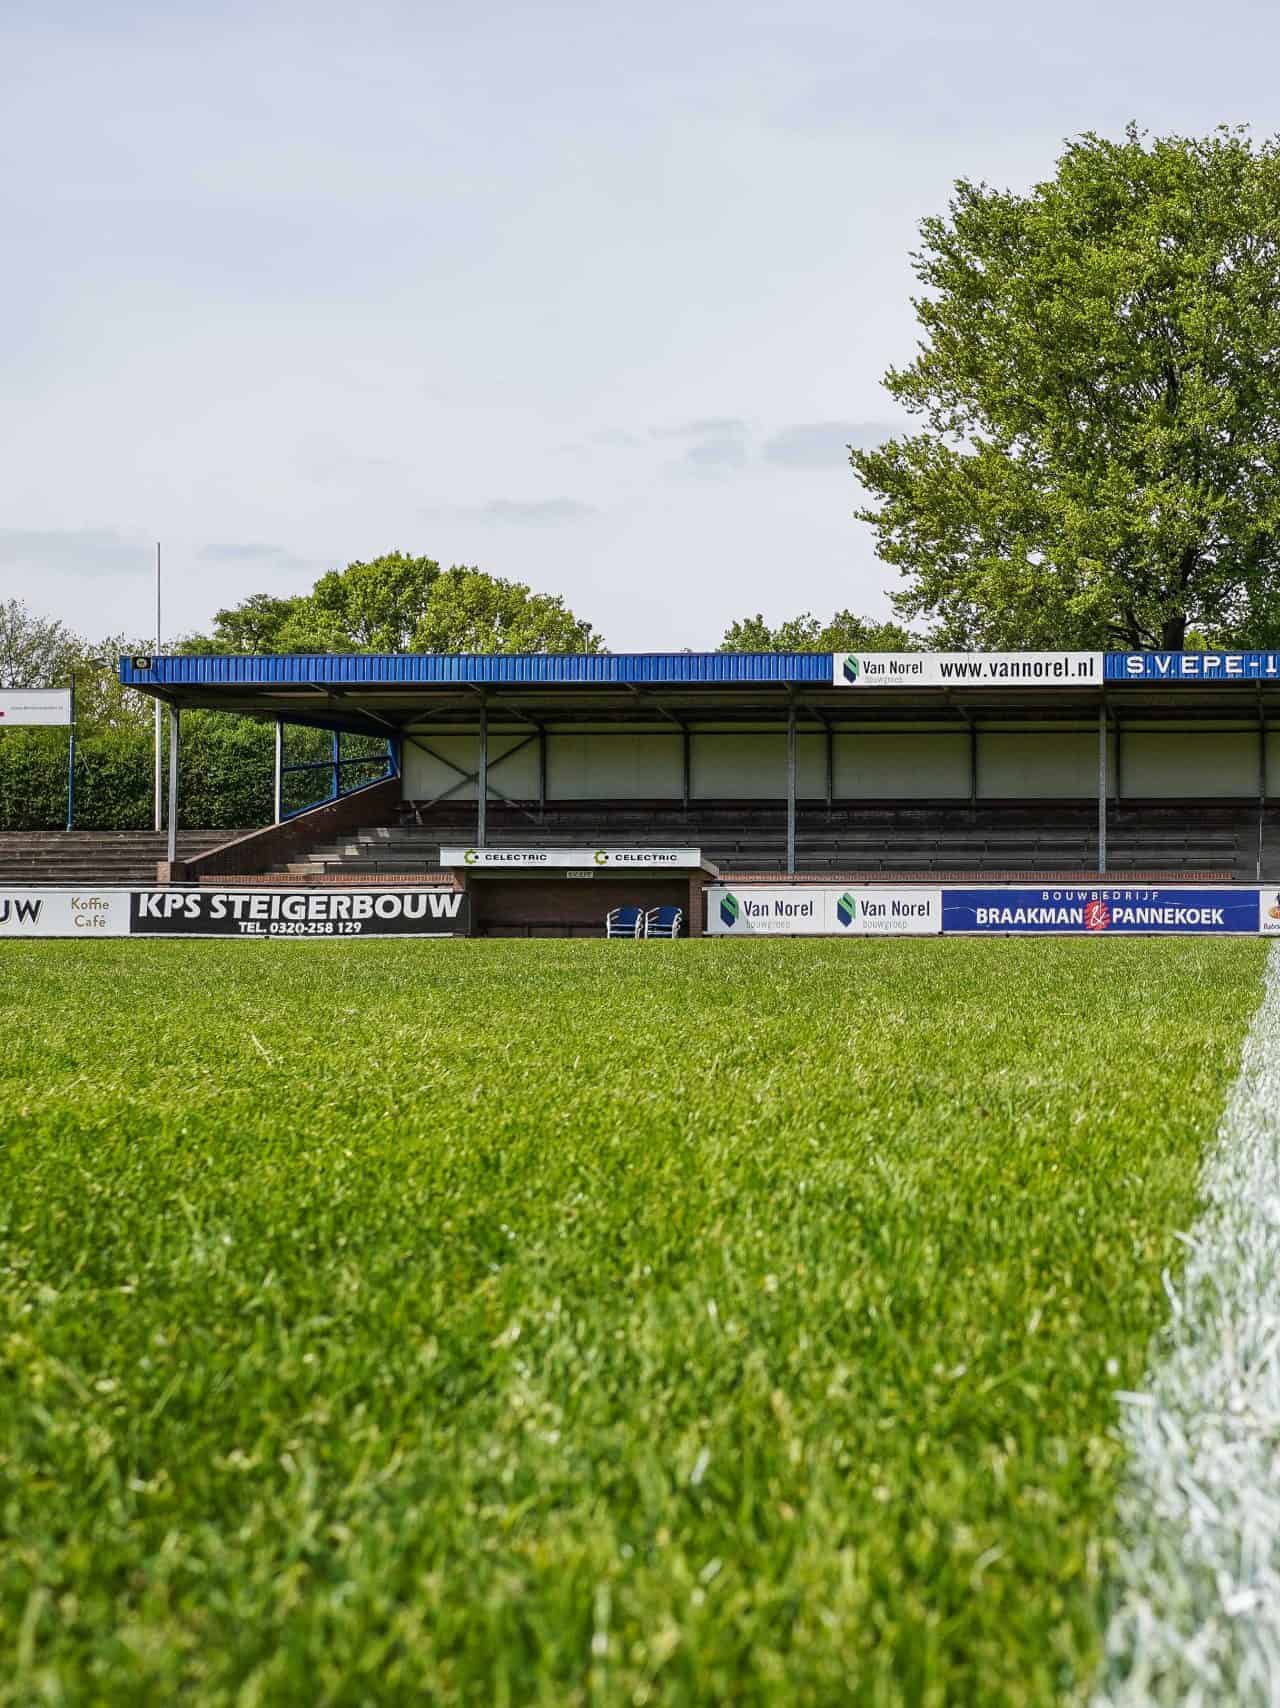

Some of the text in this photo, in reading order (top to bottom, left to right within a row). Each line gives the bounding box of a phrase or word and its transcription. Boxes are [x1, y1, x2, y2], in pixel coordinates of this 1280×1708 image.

[863, 660, 923, 675] Van Norel
[940, 657, 1094, 678] www.vannorel.nl
[484, 853, 548, 862] CELECTRIC
[615, 853, 678, 862] CELECTRIC
[1042, 891, 1160, 901] BOUWBEDRIJF
[71, 897, 110, 911] Koffie
[138, 893, 463, 919] KPS STEIGERBOUW
[743, 900, 814, 917] Van Norel
[860, 900, 930, 917] Van Norel
[975, 903, 1225, 927] BRAAKMAN & PANNEKOEK
[238, 921, 362, 934] TEL. 0320-258 129
